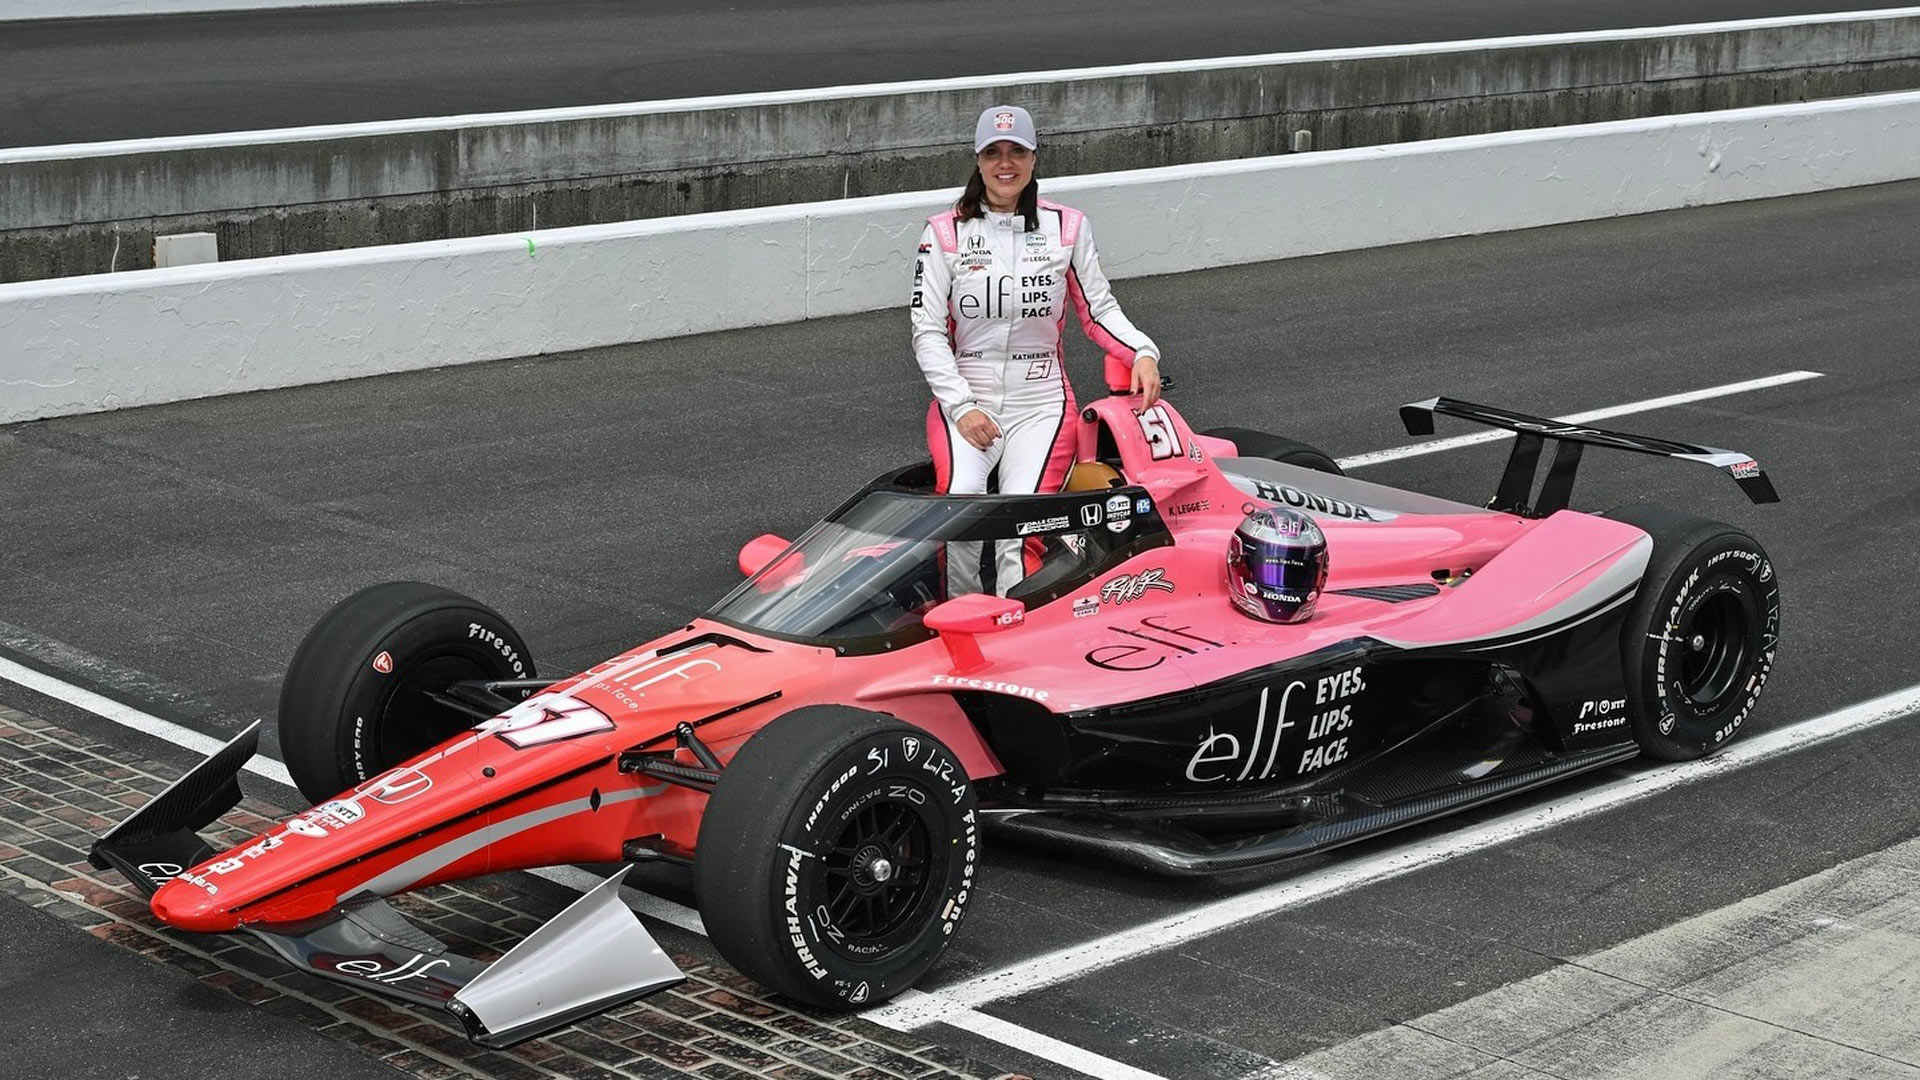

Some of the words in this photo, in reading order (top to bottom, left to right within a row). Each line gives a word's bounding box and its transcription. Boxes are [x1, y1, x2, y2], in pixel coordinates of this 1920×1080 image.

[1012, 351, 1050, 360] KATHERINE
[1025, 359, 1052, 380] 51
[1131, 404, 1184, 461] 51
[1177, 501, 1201, 514] LEGGE
[1256, 479, 1381, 523] HONDA
[1263, 591, 1302, 602] HONDA
[932, 673, 1049, 701] Firestone
[1315, 666, 1367, 705] EYES.
[1715, 649, 1776, 743] Firestone
[1307, 704, 1353, 741] LIPS.
[1572, 717, 1626, 735] Firestone
[1297, 736, 1349, 774] FACE.
[942, 809, 976, 935] Firestone
[785, 846, 828, 980] FIREHAWK
